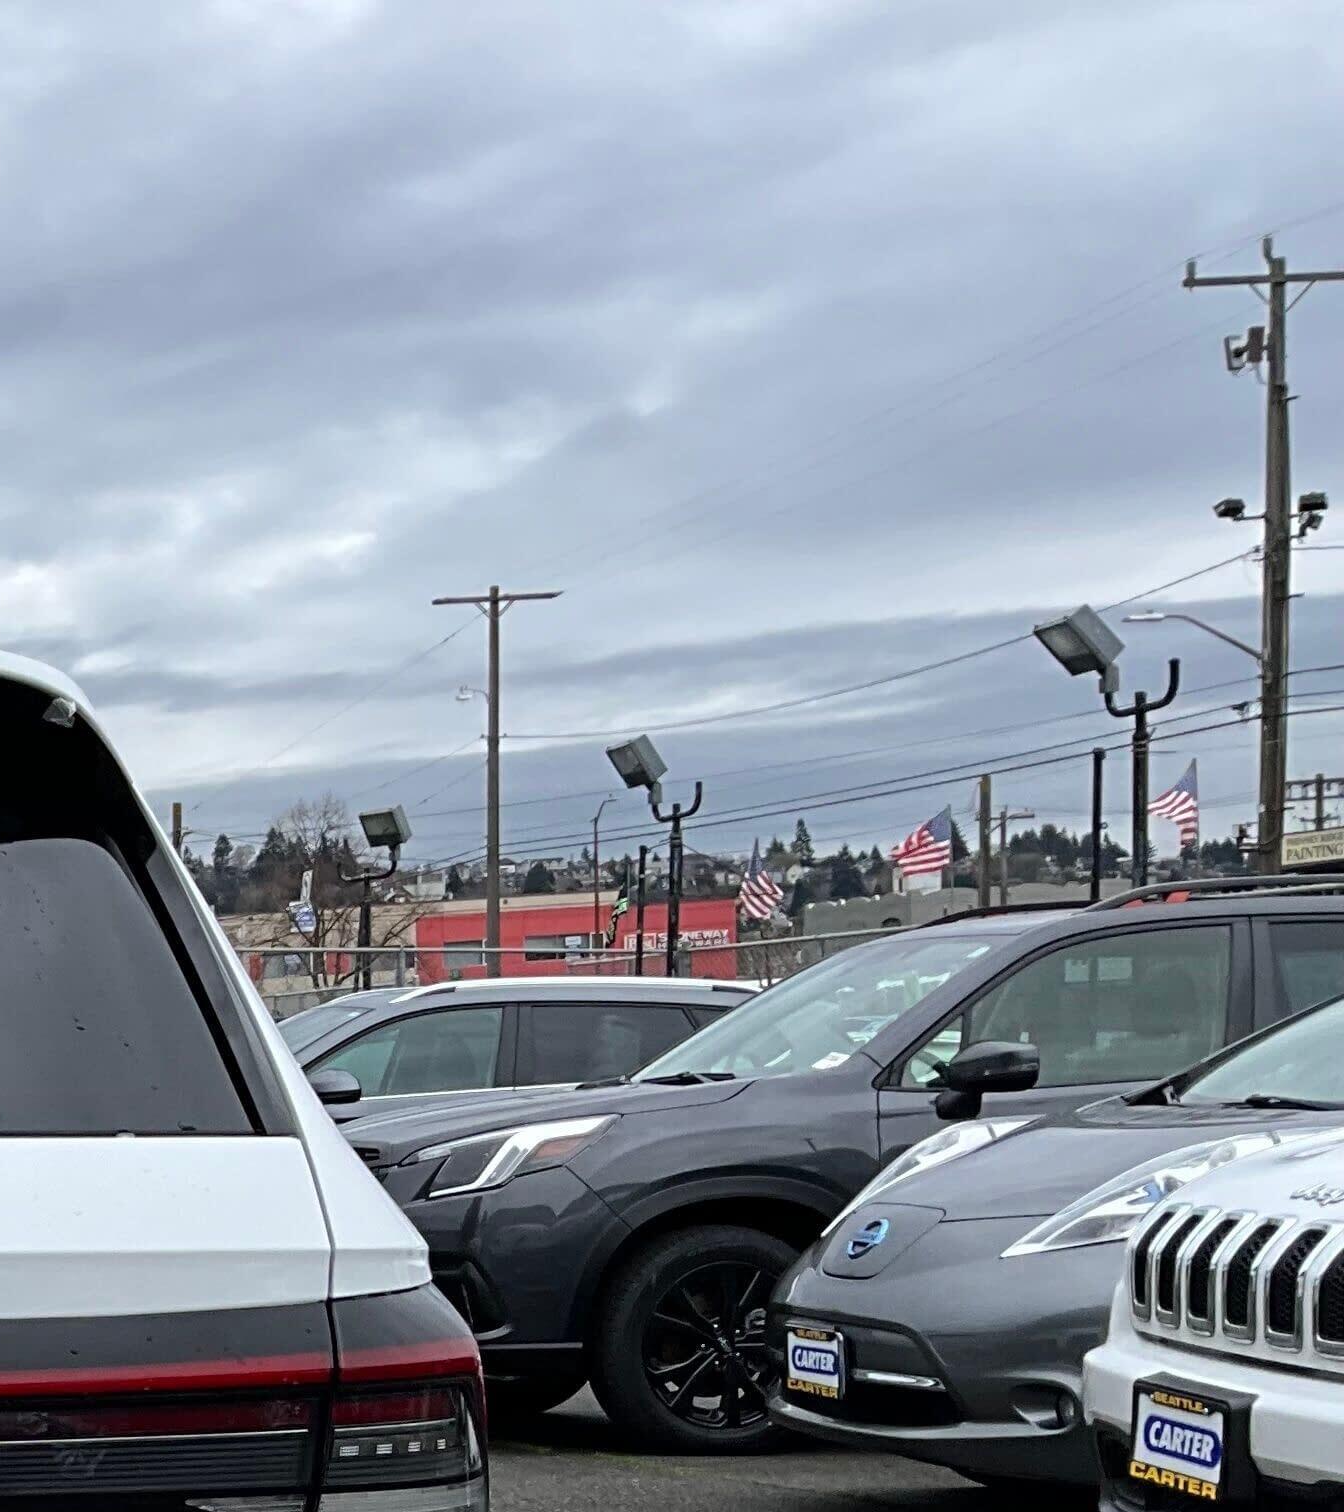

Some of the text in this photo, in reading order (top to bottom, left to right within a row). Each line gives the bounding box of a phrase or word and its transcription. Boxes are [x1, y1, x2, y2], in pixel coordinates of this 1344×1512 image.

[1286, 844, 1343, 860] PAINTING
[795, 1348, 835, 1373] CARTER
[788, 1378, 838, 1399] CARTER
[1153, 1391, 1206, 1413] SEATTLE
[1149, 1420, 1215, 1462] CARTER
[1129, 1461, 1217, 1501] CARTER
